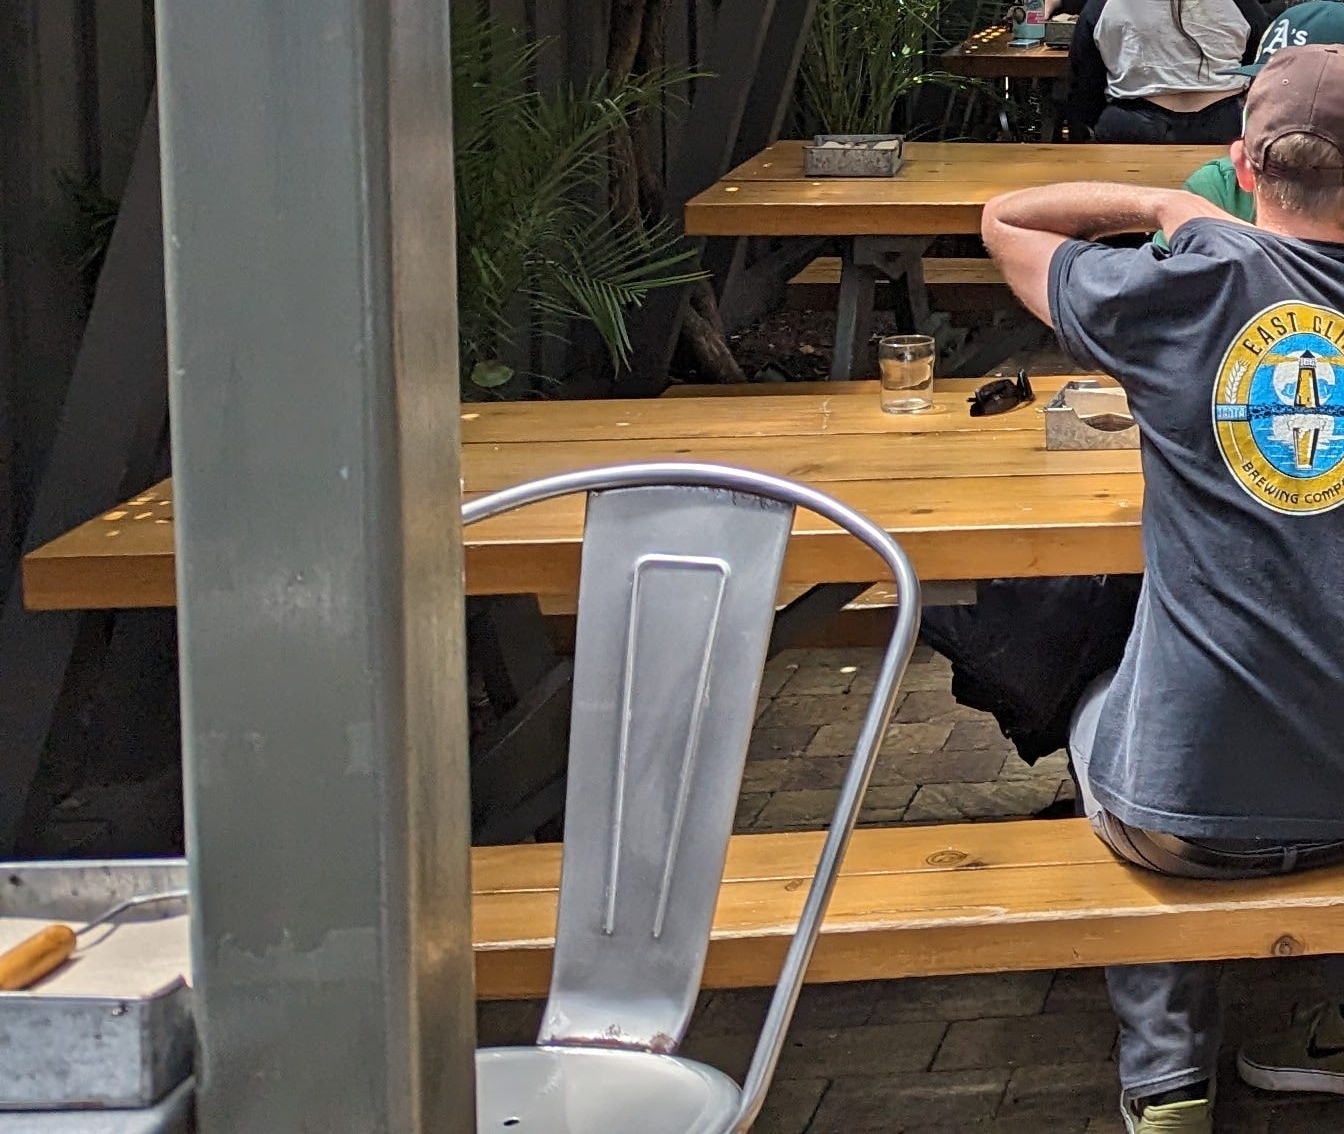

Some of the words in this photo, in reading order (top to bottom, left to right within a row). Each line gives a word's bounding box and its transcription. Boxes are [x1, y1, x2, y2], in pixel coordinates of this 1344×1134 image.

[1262, 18, 1309, 55] A's
[1242, 312, 1297, 356] EAST
[1242, 461, 1299, 505] BREWING
